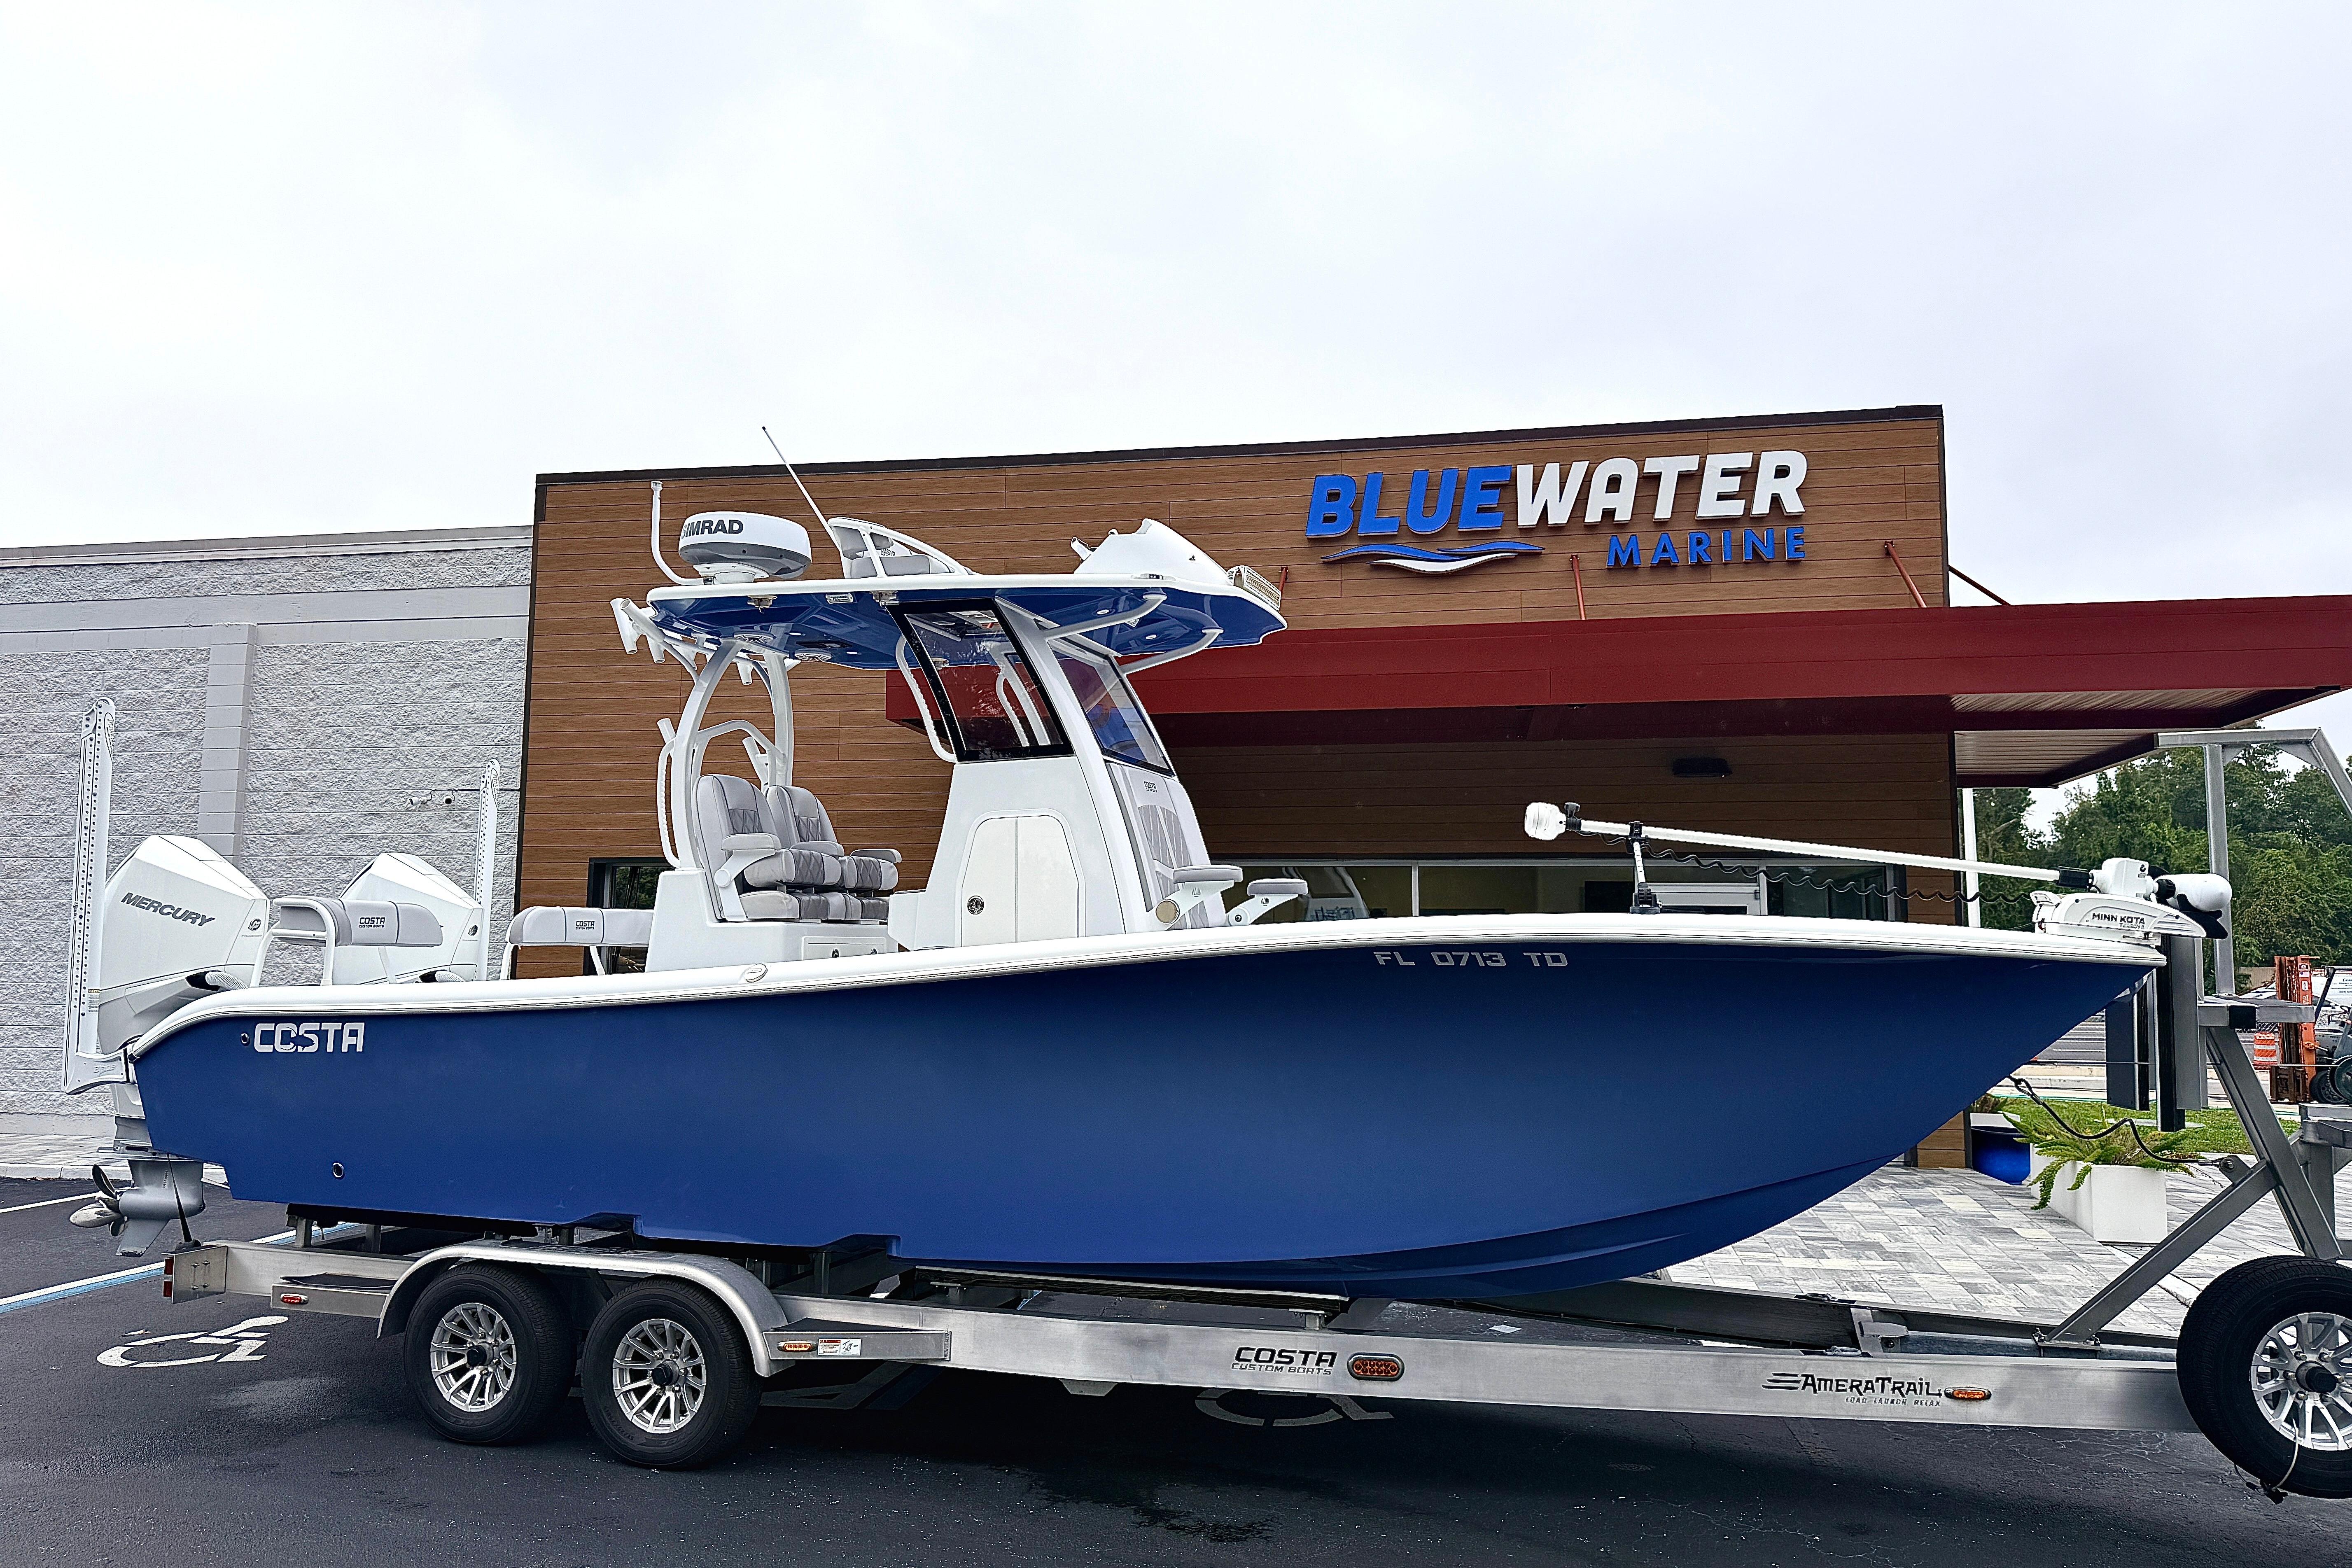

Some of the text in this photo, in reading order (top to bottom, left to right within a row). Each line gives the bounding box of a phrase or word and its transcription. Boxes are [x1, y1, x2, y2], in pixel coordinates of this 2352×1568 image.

[1306, 450, 1807, 538] BLUEWATER
[681, 519, 744, 539] SIMRAD
[1606, 526, 1805, 569] MARINE
[121, 892, 216, 926] MERCURY
[2092, 912, 2145, 924] MINN KOTA
[1373, 952, 1568, 966] FL 0713 TD
[254, 1022, 365, 1052] COSTA
[1235, 1346, 1338, 1367] COSTA
[1231, 1363, 1332, 1375] CUSTOM BOATS
